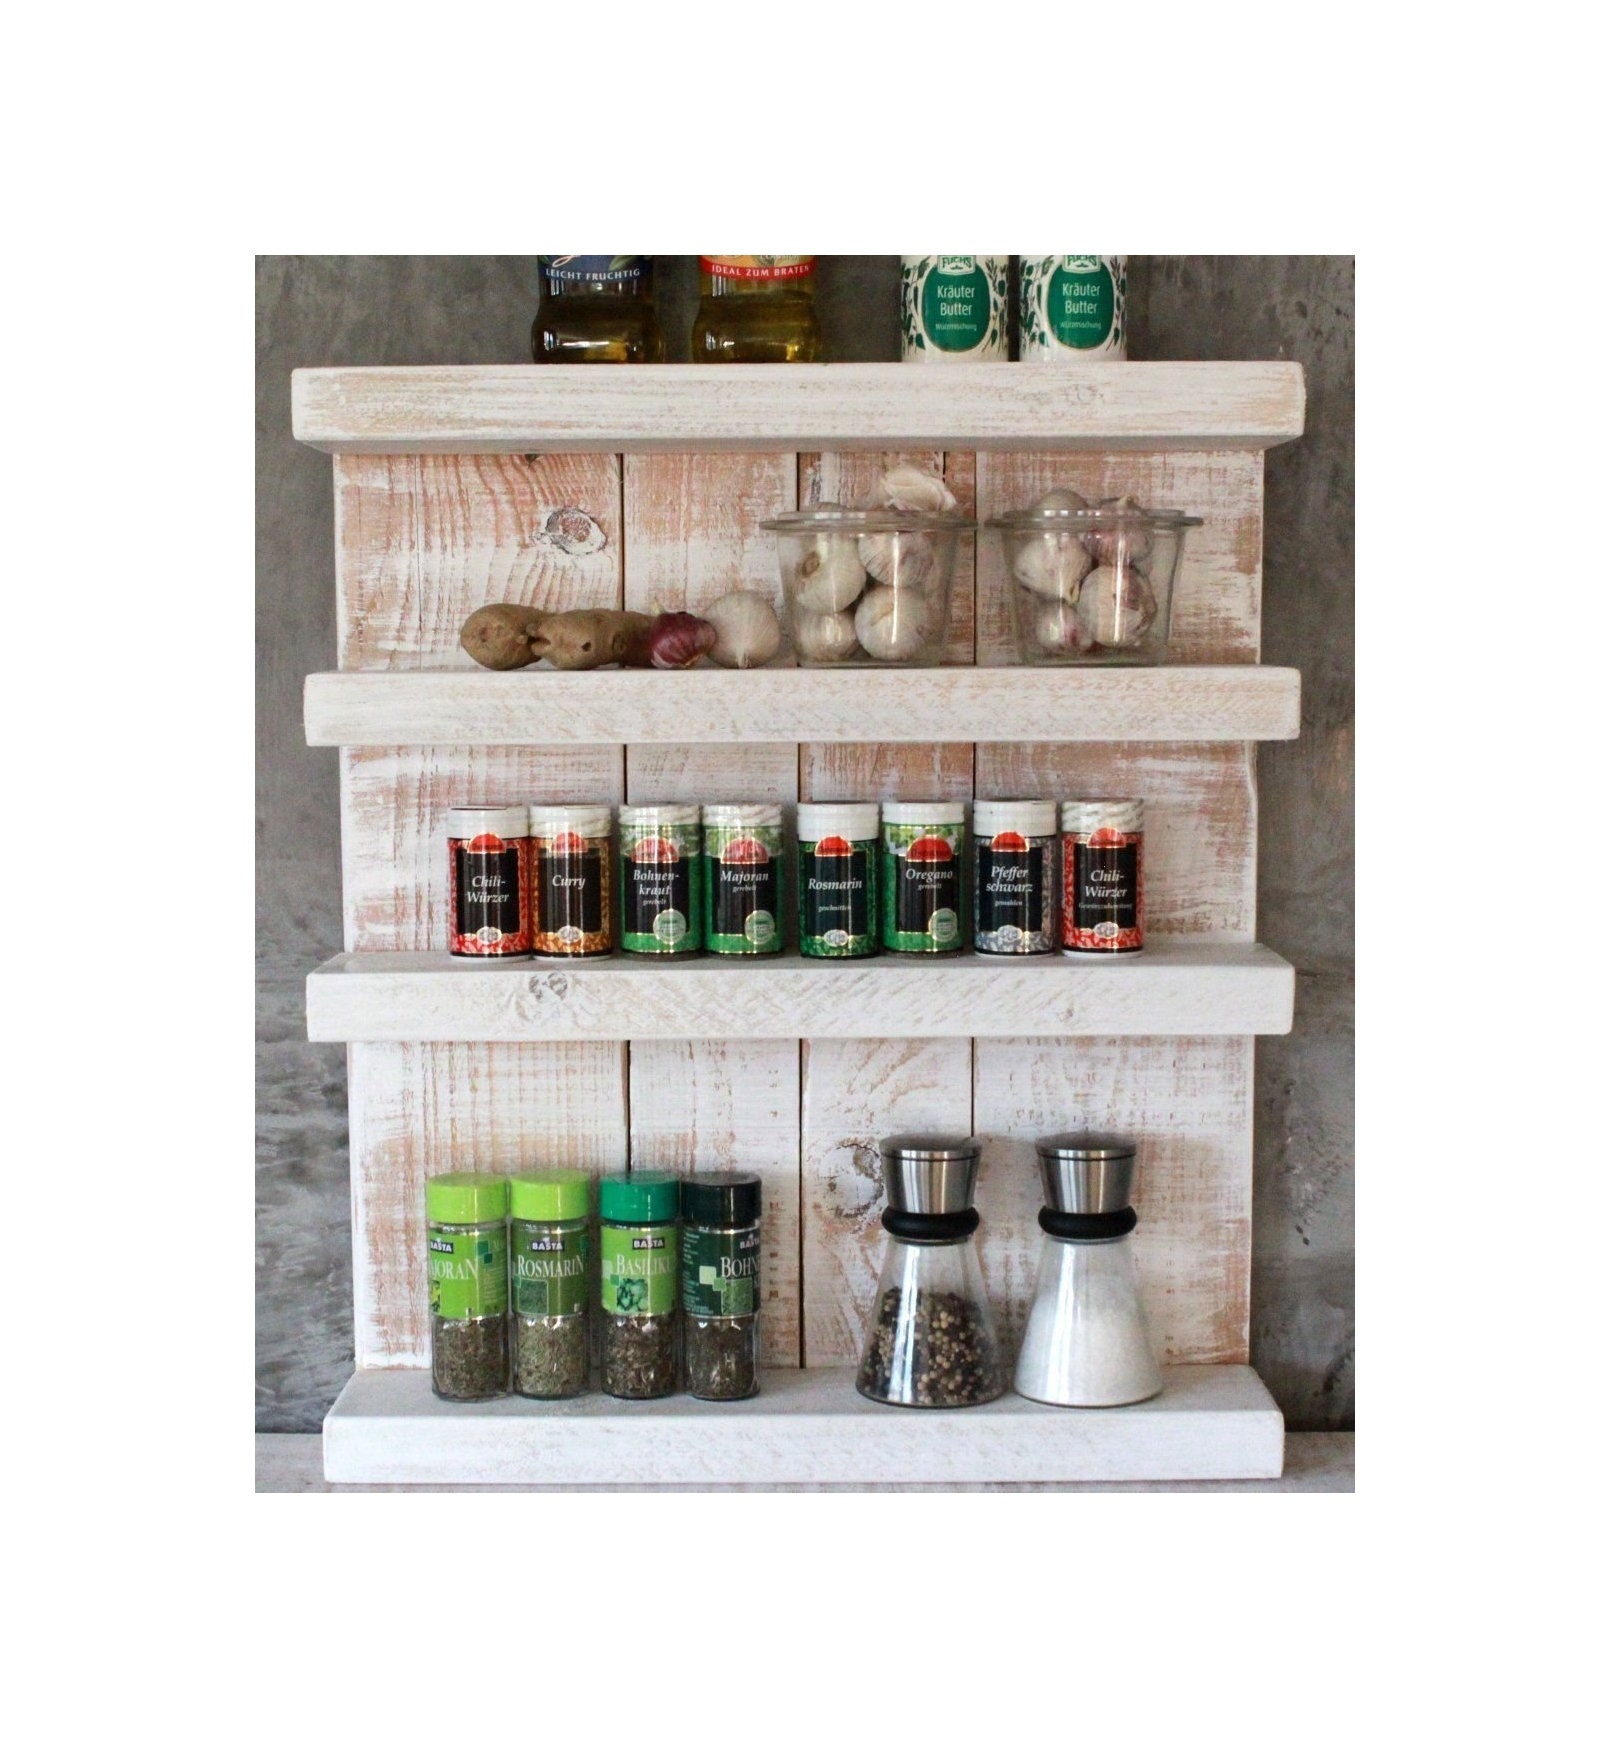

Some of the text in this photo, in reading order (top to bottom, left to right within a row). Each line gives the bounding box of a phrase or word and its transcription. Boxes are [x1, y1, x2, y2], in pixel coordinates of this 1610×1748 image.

[546, 268, 581, 280] LEICHT
[712, 264, 741, 276] IDEAL
[746, 268, 769, 277] ZUM
[937, 284, 975, 298] Kräuter
[1062, 282, 1100, 296] Kräuter
[940, 302, 973, 316] Butter
[1065, 300, 1098, 314] Butter
[633, 870, 680, 882] Bohnen-
[720, 870, 770, 885] Majoran
[906, 868, 952, 883] Oregano
[991, 866, 1029, 882] Pfeffer
[1090, 869, 1125, 882] Chili-
[472, 875, 506, 888] Chili-
[552, 875, 586, 890] Curry
[808, 878, 862, 890] Rosmarin
[986, 881, 1033, 892] schwarz
[639, 884, 671, 896] kraut
[1084, 886, 1127, 898] Würzer
[467, 891, 509, 903] Würzer
[532, 1242, 563, 1250] BASTA
[633, 1239, 664, 1249] BASTA
[518, 1254, 584, 1277] ROSMARIN
